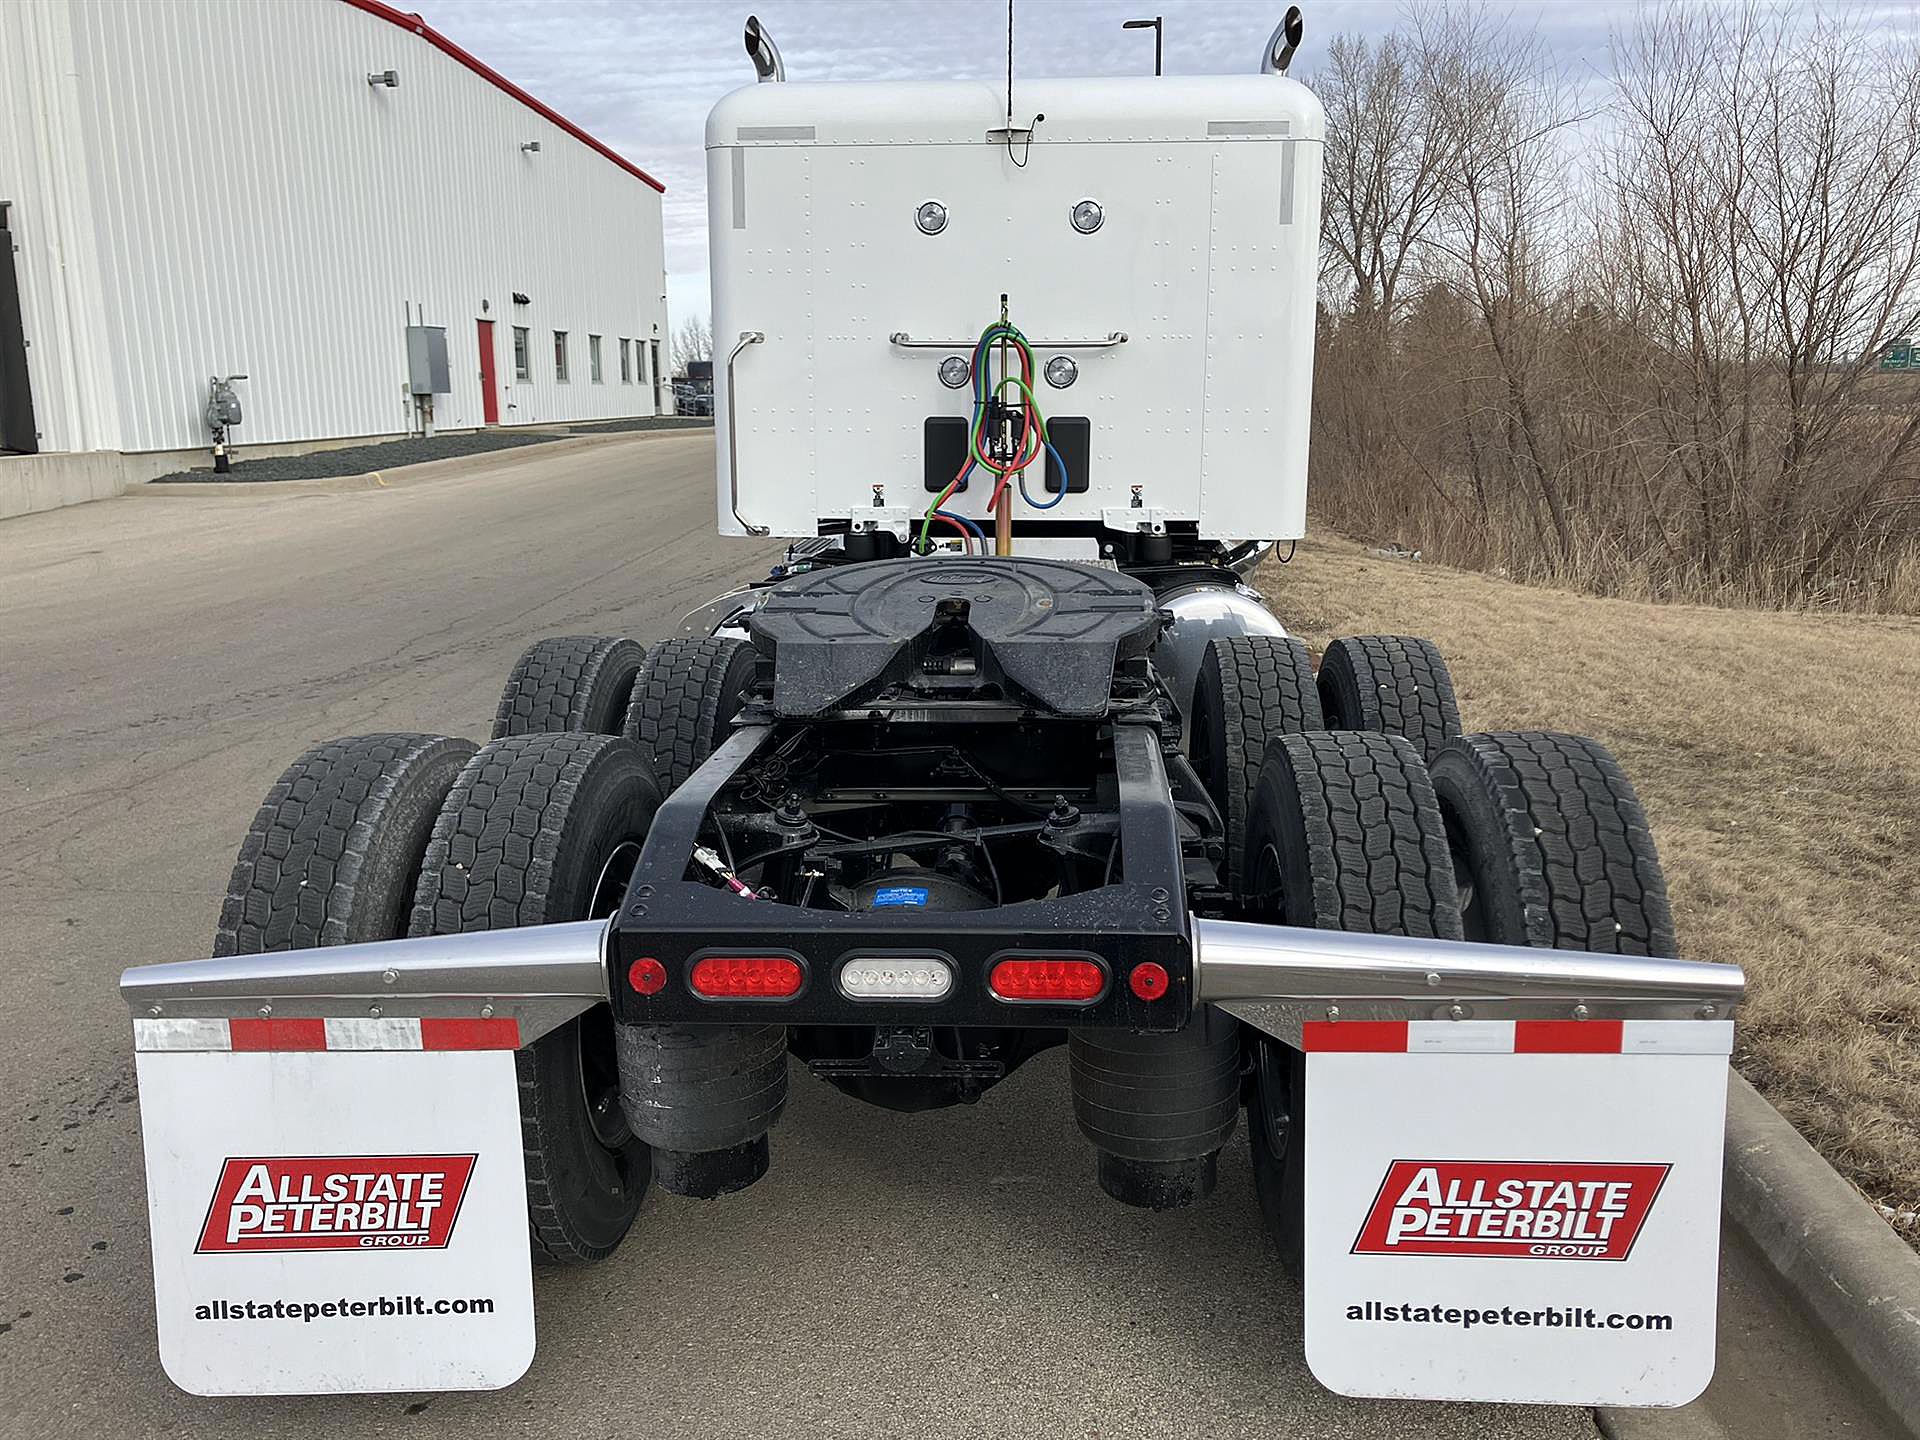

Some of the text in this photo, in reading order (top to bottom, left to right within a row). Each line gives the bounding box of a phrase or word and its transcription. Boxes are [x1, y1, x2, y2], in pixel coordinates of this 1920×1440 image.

[233, 1164, 444, 1203] ALLSTATE
[1396, 1167, 1632, 1209] ALLSTATE
[226, 1202, 440, 1243] PETERBILT
[1385, 1207, 1624, 1245] PETERBILT
[359, 1235, 430, 1246] GROUP
[1530, 1245, 1608, 1256] GROUP
[195, 1296, 494, 1322] allstatepeterbilt.com
[1346, 1302, 1673, 1329] allstatepeterbilt.com
